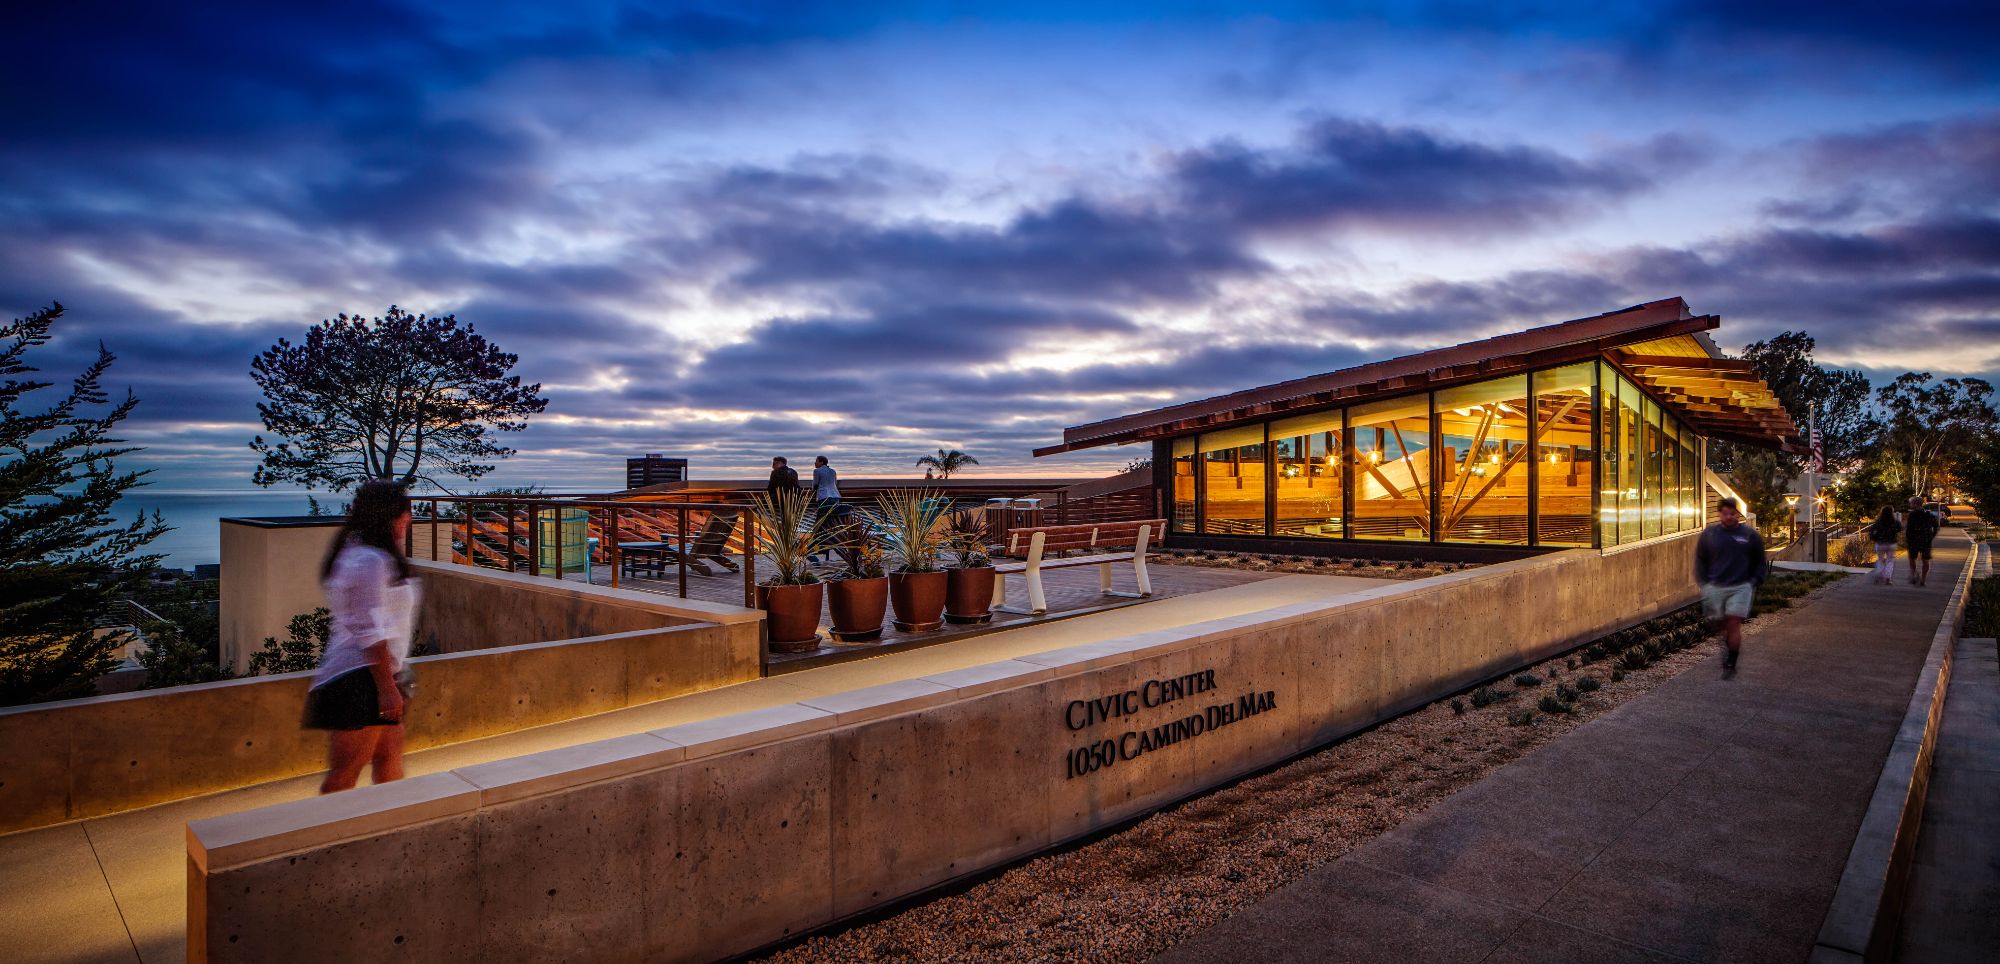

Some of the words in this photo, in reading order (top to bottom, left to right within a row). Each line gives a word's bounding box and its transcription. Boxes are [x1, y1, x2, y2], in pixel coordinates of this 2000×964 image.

[1065, 691, 1138, 731] CIVIC
[1143, 669, 1217, 708] CENTER
[1066, 739, 1116, 780] 1050
[1119, 714, 1204, 761] CAMINO
[1206, 703, 1240, 732] DEL
[1238, 690, 1277, 719] MAR
